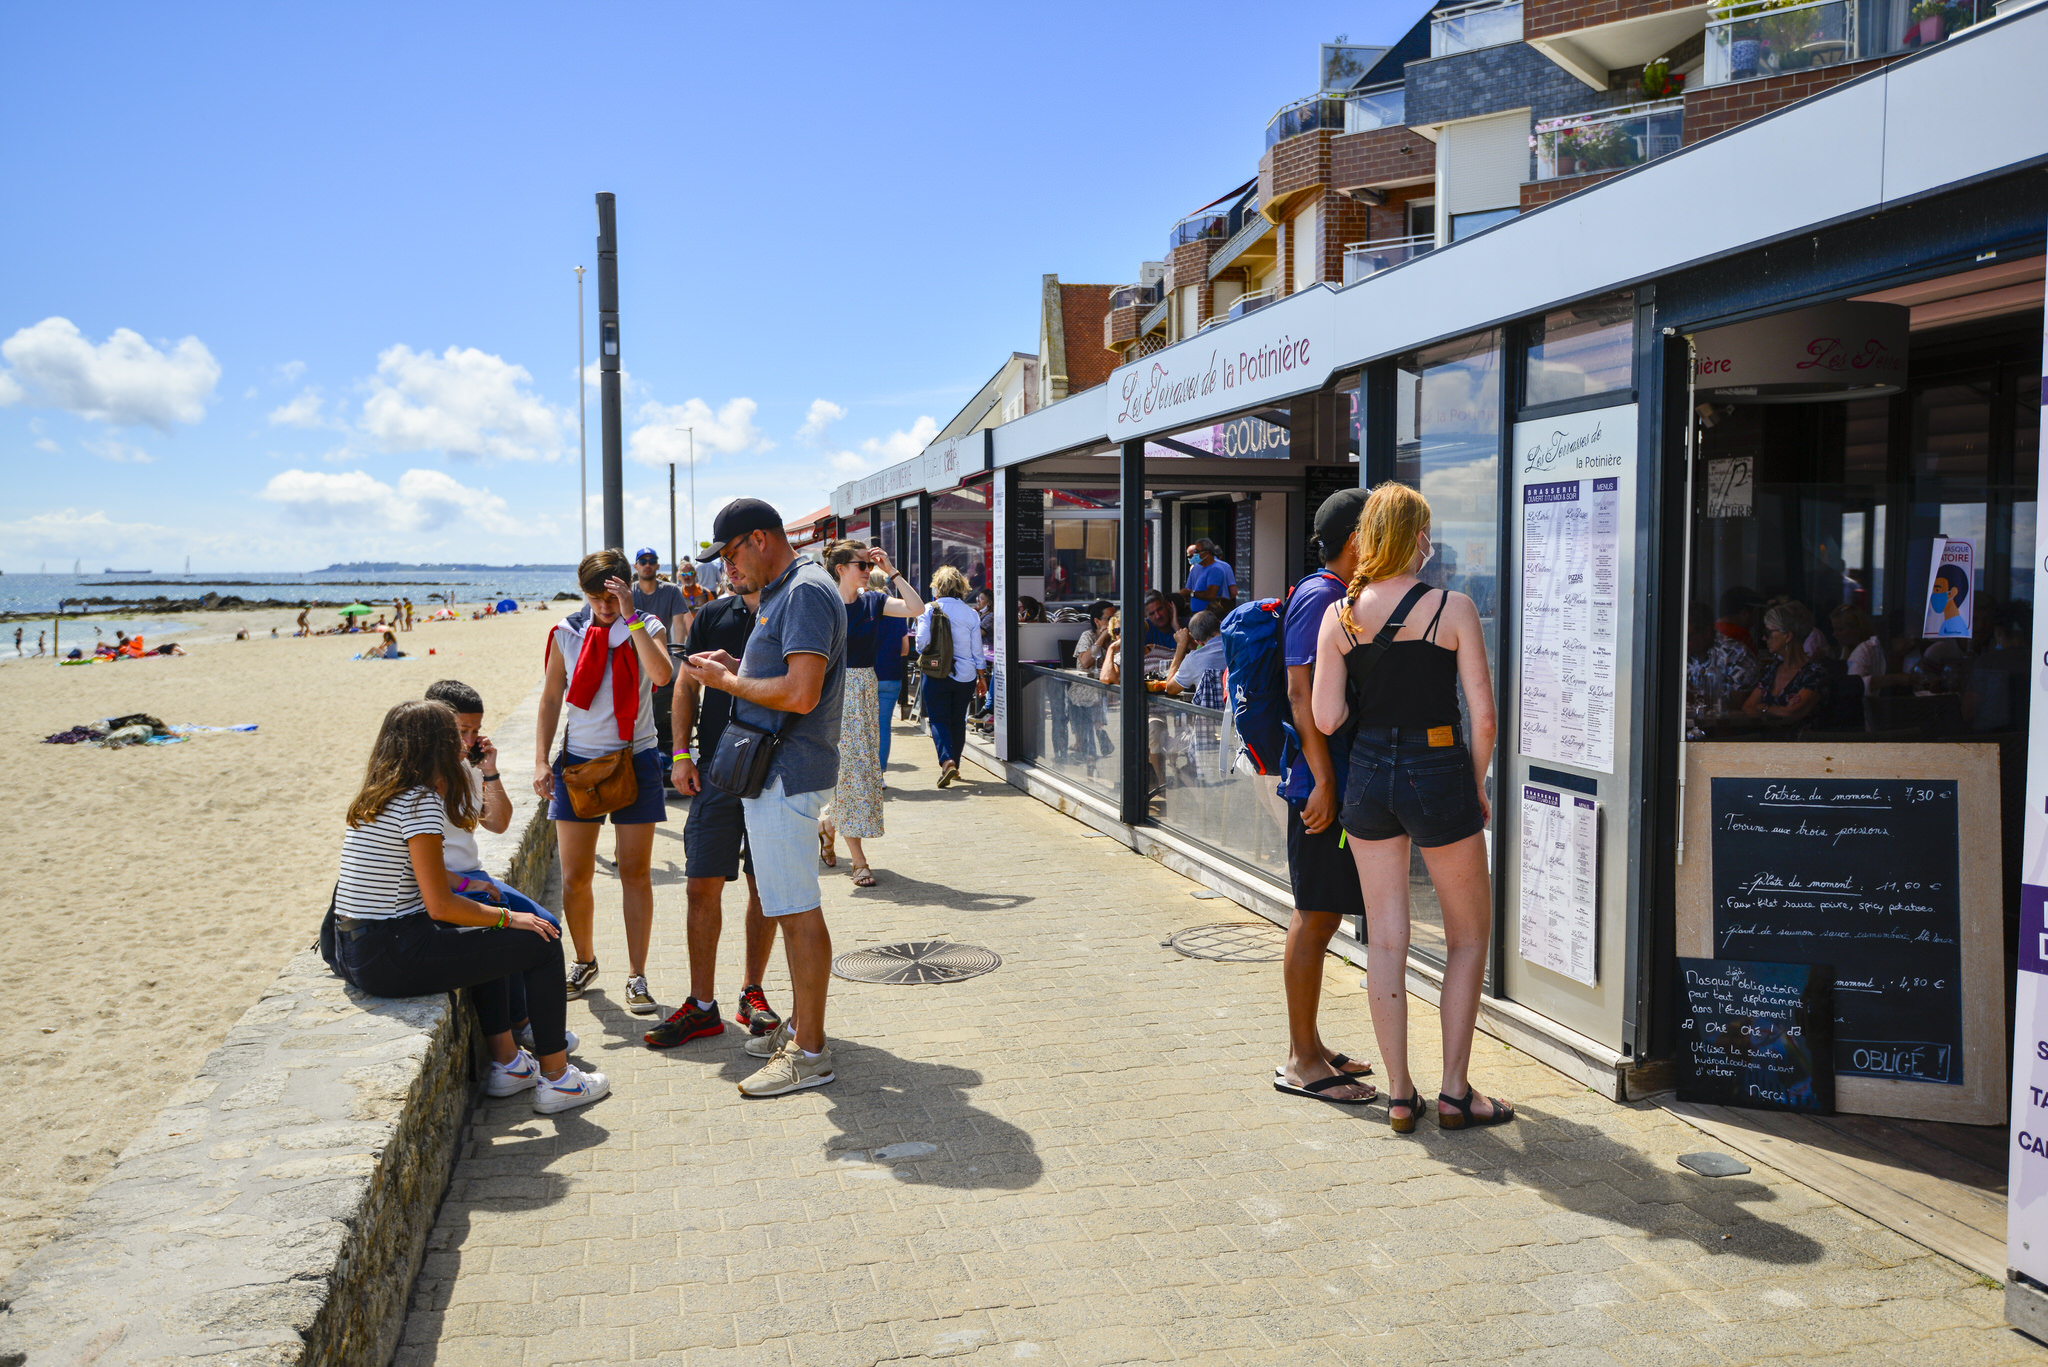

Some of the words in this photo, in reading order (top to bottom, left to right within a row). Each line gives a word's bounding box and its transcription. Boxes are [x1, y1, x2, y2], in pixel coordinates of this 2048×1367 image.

[1796, 338, 1848, 371] Les
[1118, 371, 1142, 424] Les
[1144, 362, 1200, 415] Terrasses
[1201, 349, 1217, 396] de
[1223, 358, 1234, 390] la
[1239, 335, 1310, 385] Potinière
[1525, 445, 1554, 473] Les
[1545, 431, 1589, 463] Terrasses
[1591, 421, 1602, 443] de
[1576, 457, 1583, 469] la
[1585, 454, 1622, 468] Potinière
[1527, 486, 1577, 496] BRASSERIE
[1596, 483, 1614, 491] MENUS
[1764, 784, 1802, 801] Entrée
[1809, 787, 1823, 801] du
[1831, 788, 1883, 802] moment
[1939, 790, 1952, 799] €
[1724, 812, 1768, 832] Terrine
[1771, 826, 1791, 836] aux
[1795, 819, 1829, 837] trois
[1789, 875, 1802, 888] du
[1806, 876, 1854, 890] moment
[1782, 901, 1815, 909] sauce
[1858, 900, 1884, 915] spicy
[1758, 924, 1773, 936] de
[1819, 930, 1852, 939] sauce
[1738, 978, 1800, 996] obligatoire
[1933, 979, 1945, 989] €
[1688, 990, 1709, 1003] pour
[1713, 990, 1733, 1002] tout
[1691, 1003, 1713, 1014] dans
[1705, 1022, 1728, 1033] Ohé
[1740, 1025, 1762, 1037] Ohé
[1690, 1042, 1726, 1055] Utilisez
[1748, 1049, 1784, 1060] solution
[1768, 1065, 1795, 1073] avant
[1749, 1084, 1785, 1101] Merci
